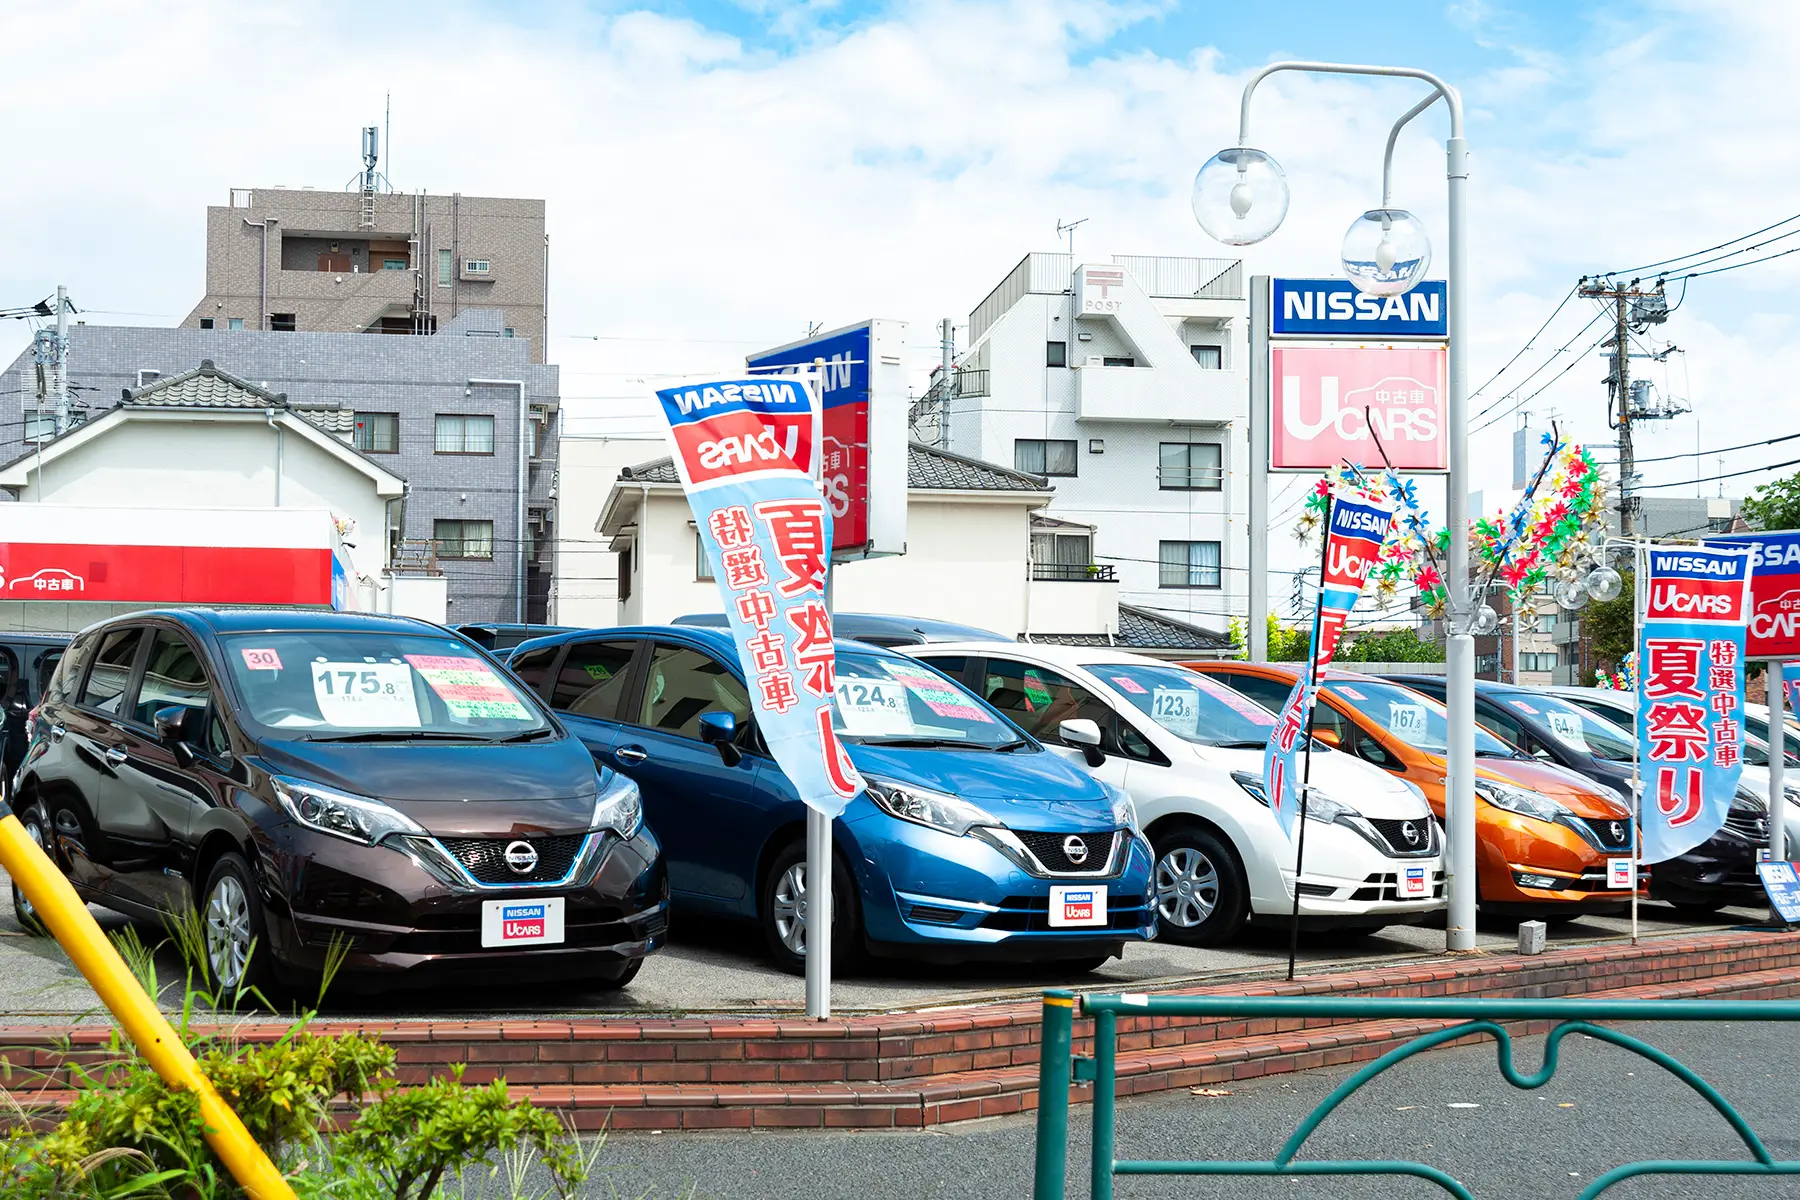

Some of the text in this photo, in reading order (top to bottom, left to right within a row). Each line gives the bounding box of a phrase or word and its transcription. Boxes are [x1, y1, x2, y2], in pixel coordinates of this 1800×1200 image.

[1085, 300, 1122, 312] POST
[1283, 290, 1440, 322] NISSAN
[1375, 389, 1425, 405] 中古車
[1335, 508, 1389, 536] NISSAN
[1656, 556, 1738, 576] NISSAN
[33, 577, 75, 591] 中古車
[1653, 584, 1733, 615] UCARS
[248, 652, 274, 665] 30
[317, 670, 396, 695] 175.8
[838, 684, 897, 709] 124.8
[1155, 696, 1191, 717] 123.8
[1709, 640, 1740, 769] 特選中古車
[1644, 638, 1709, 829] 夏祭り
[1066, 893, 1091, 902] NISSAN
[506, 908, 541, 918] NISSAN
[1066, 906, 1091, 918] UCARS
[506, 922, 541, 937] UCARS
